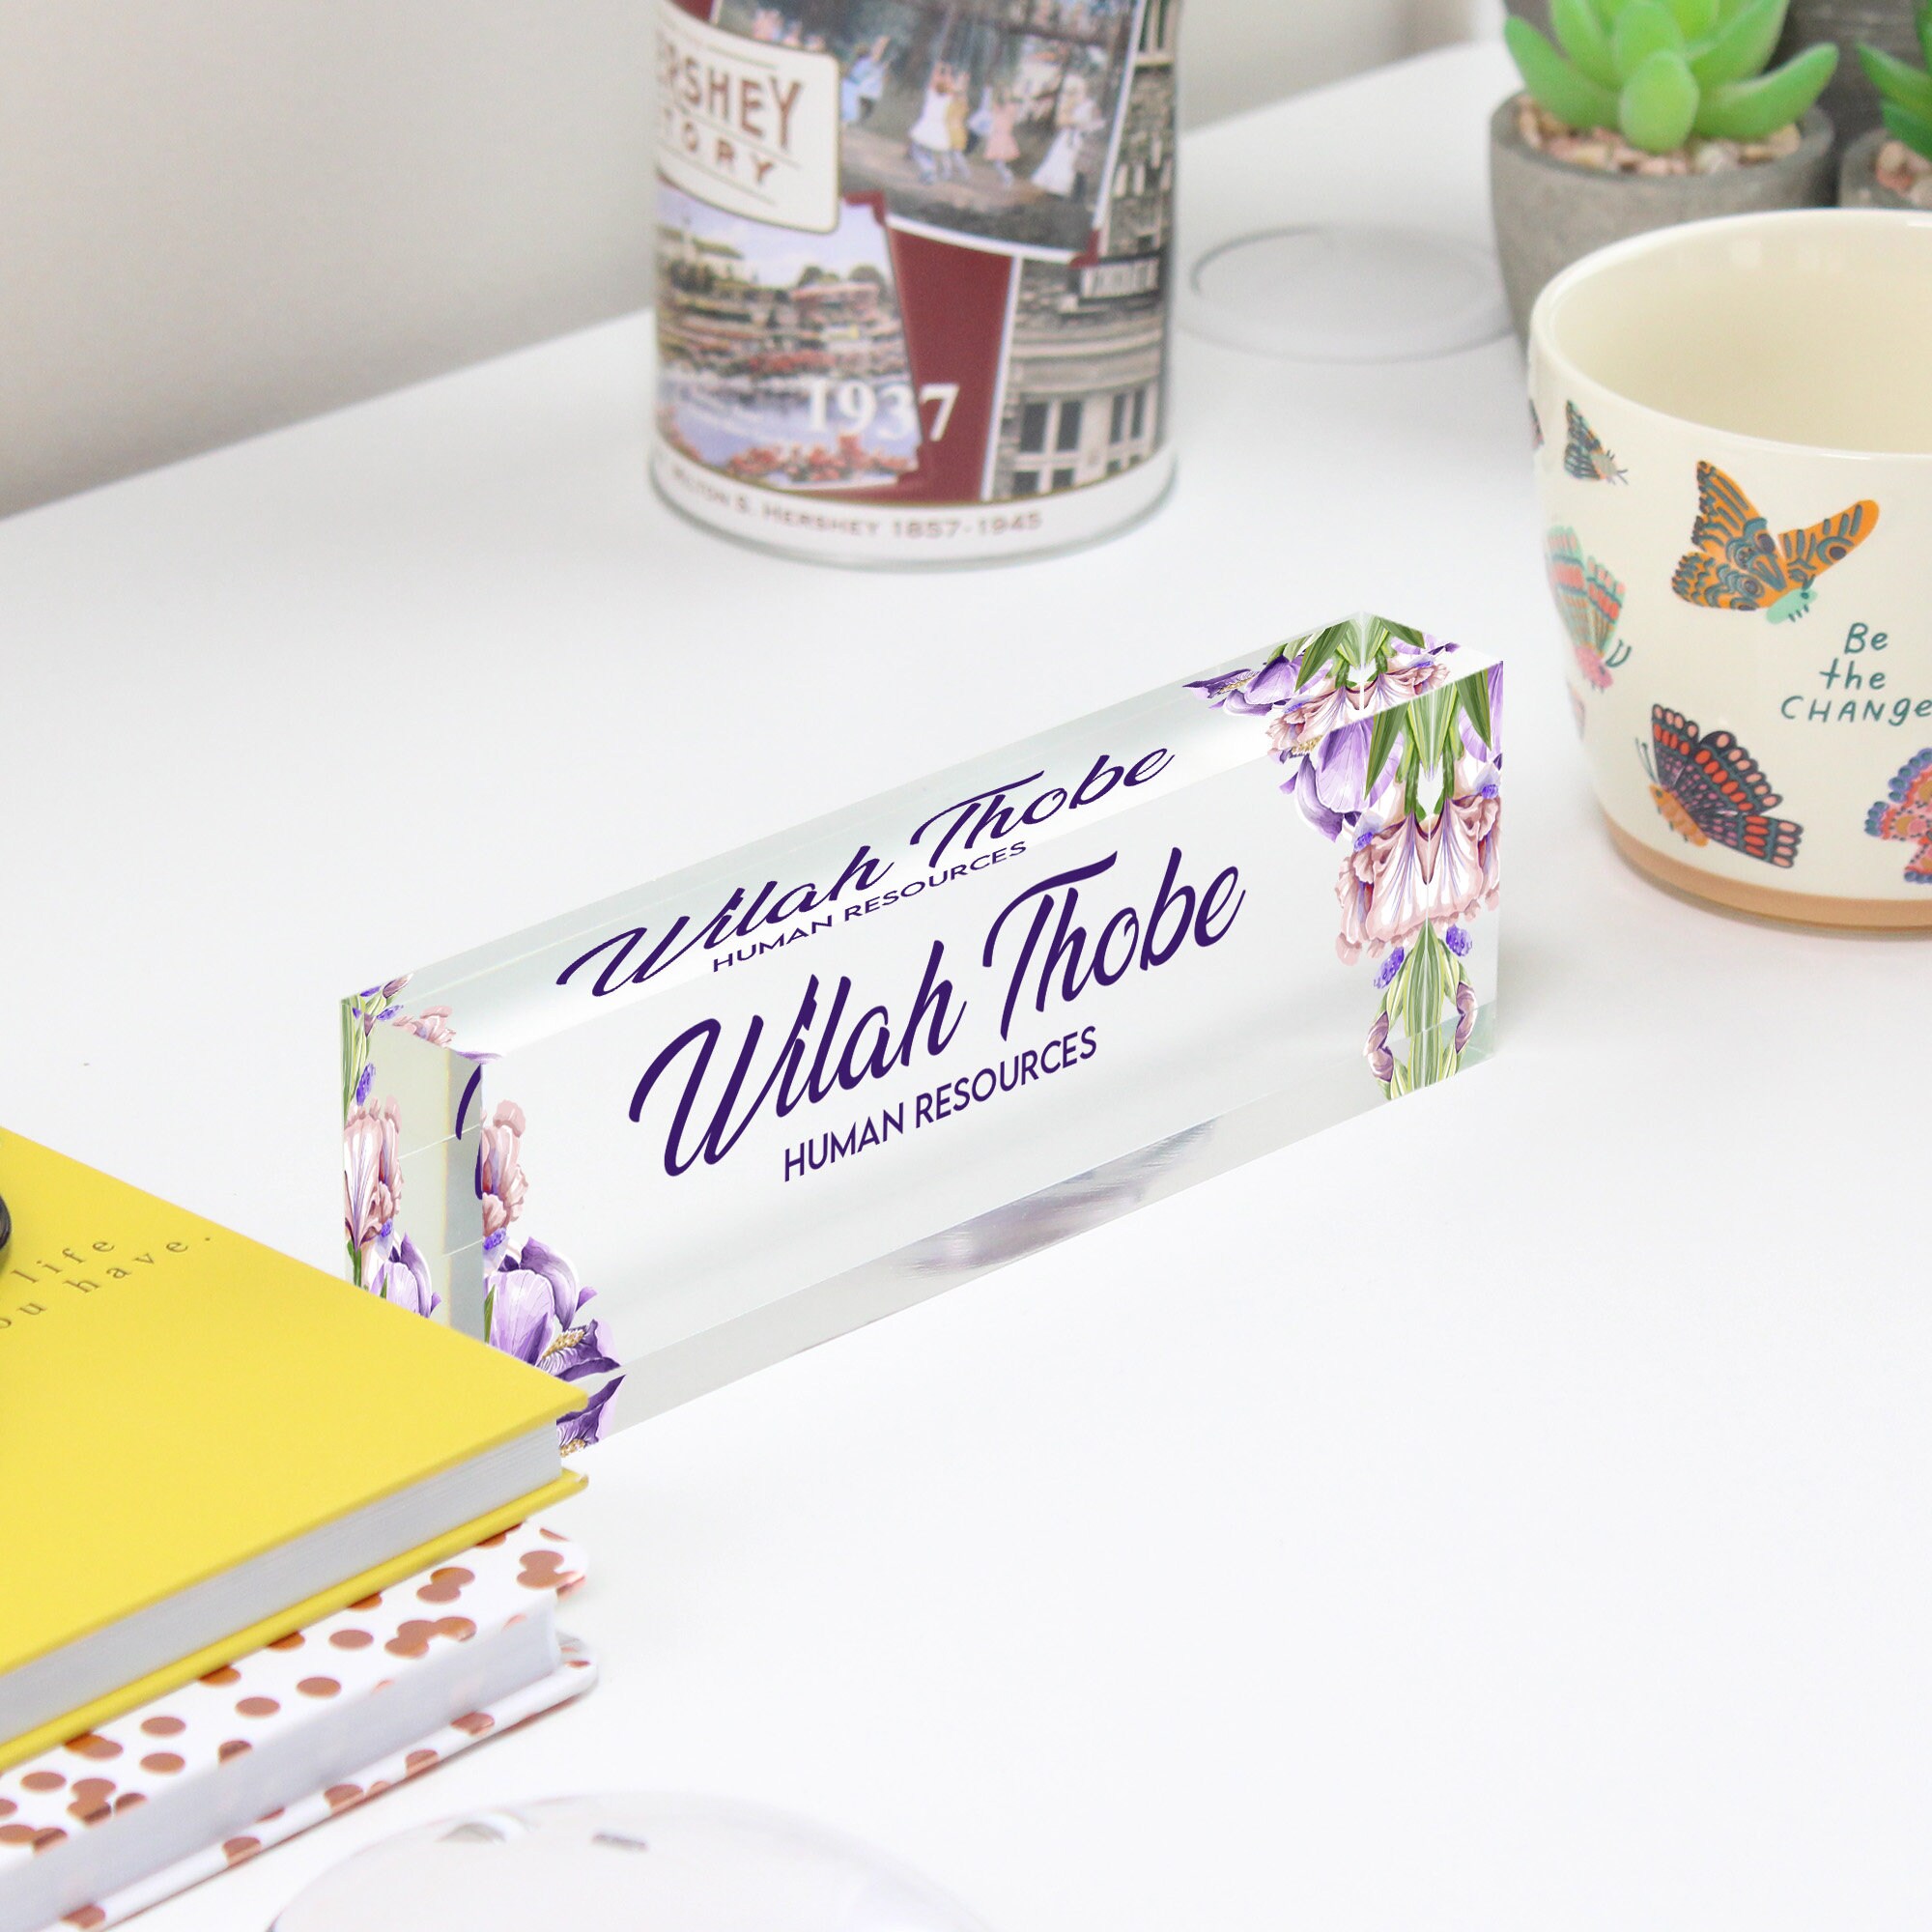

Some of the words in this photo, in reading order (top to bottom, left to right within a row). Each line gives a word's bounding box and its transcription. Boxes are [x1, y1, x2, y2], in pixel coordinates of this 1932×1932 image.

[809, 377, 960, 441] 1937
[762, 501, 878, 535] HERSHEY
[893, 511, 1043, 539] 1857-1945
[1842, 621, 1889, 656] Be
[1818, 657, 1887, 691] the
[555, 844, 895, 998] Wilah
[910, 748, 1176, 868] Thobe
[713, 914, 834, 973] HUMAN
[844, 840, 1027, 923] RESOURCES
[628, 939, 968, 1178] Wilah
[981, 846, 1246, 1042] Thobe
[784, 1101, 904, 1182] HUMAN
[914, 1025, 1098, 1129] RESOURCES
[10, 1240, 115, 1284] life
